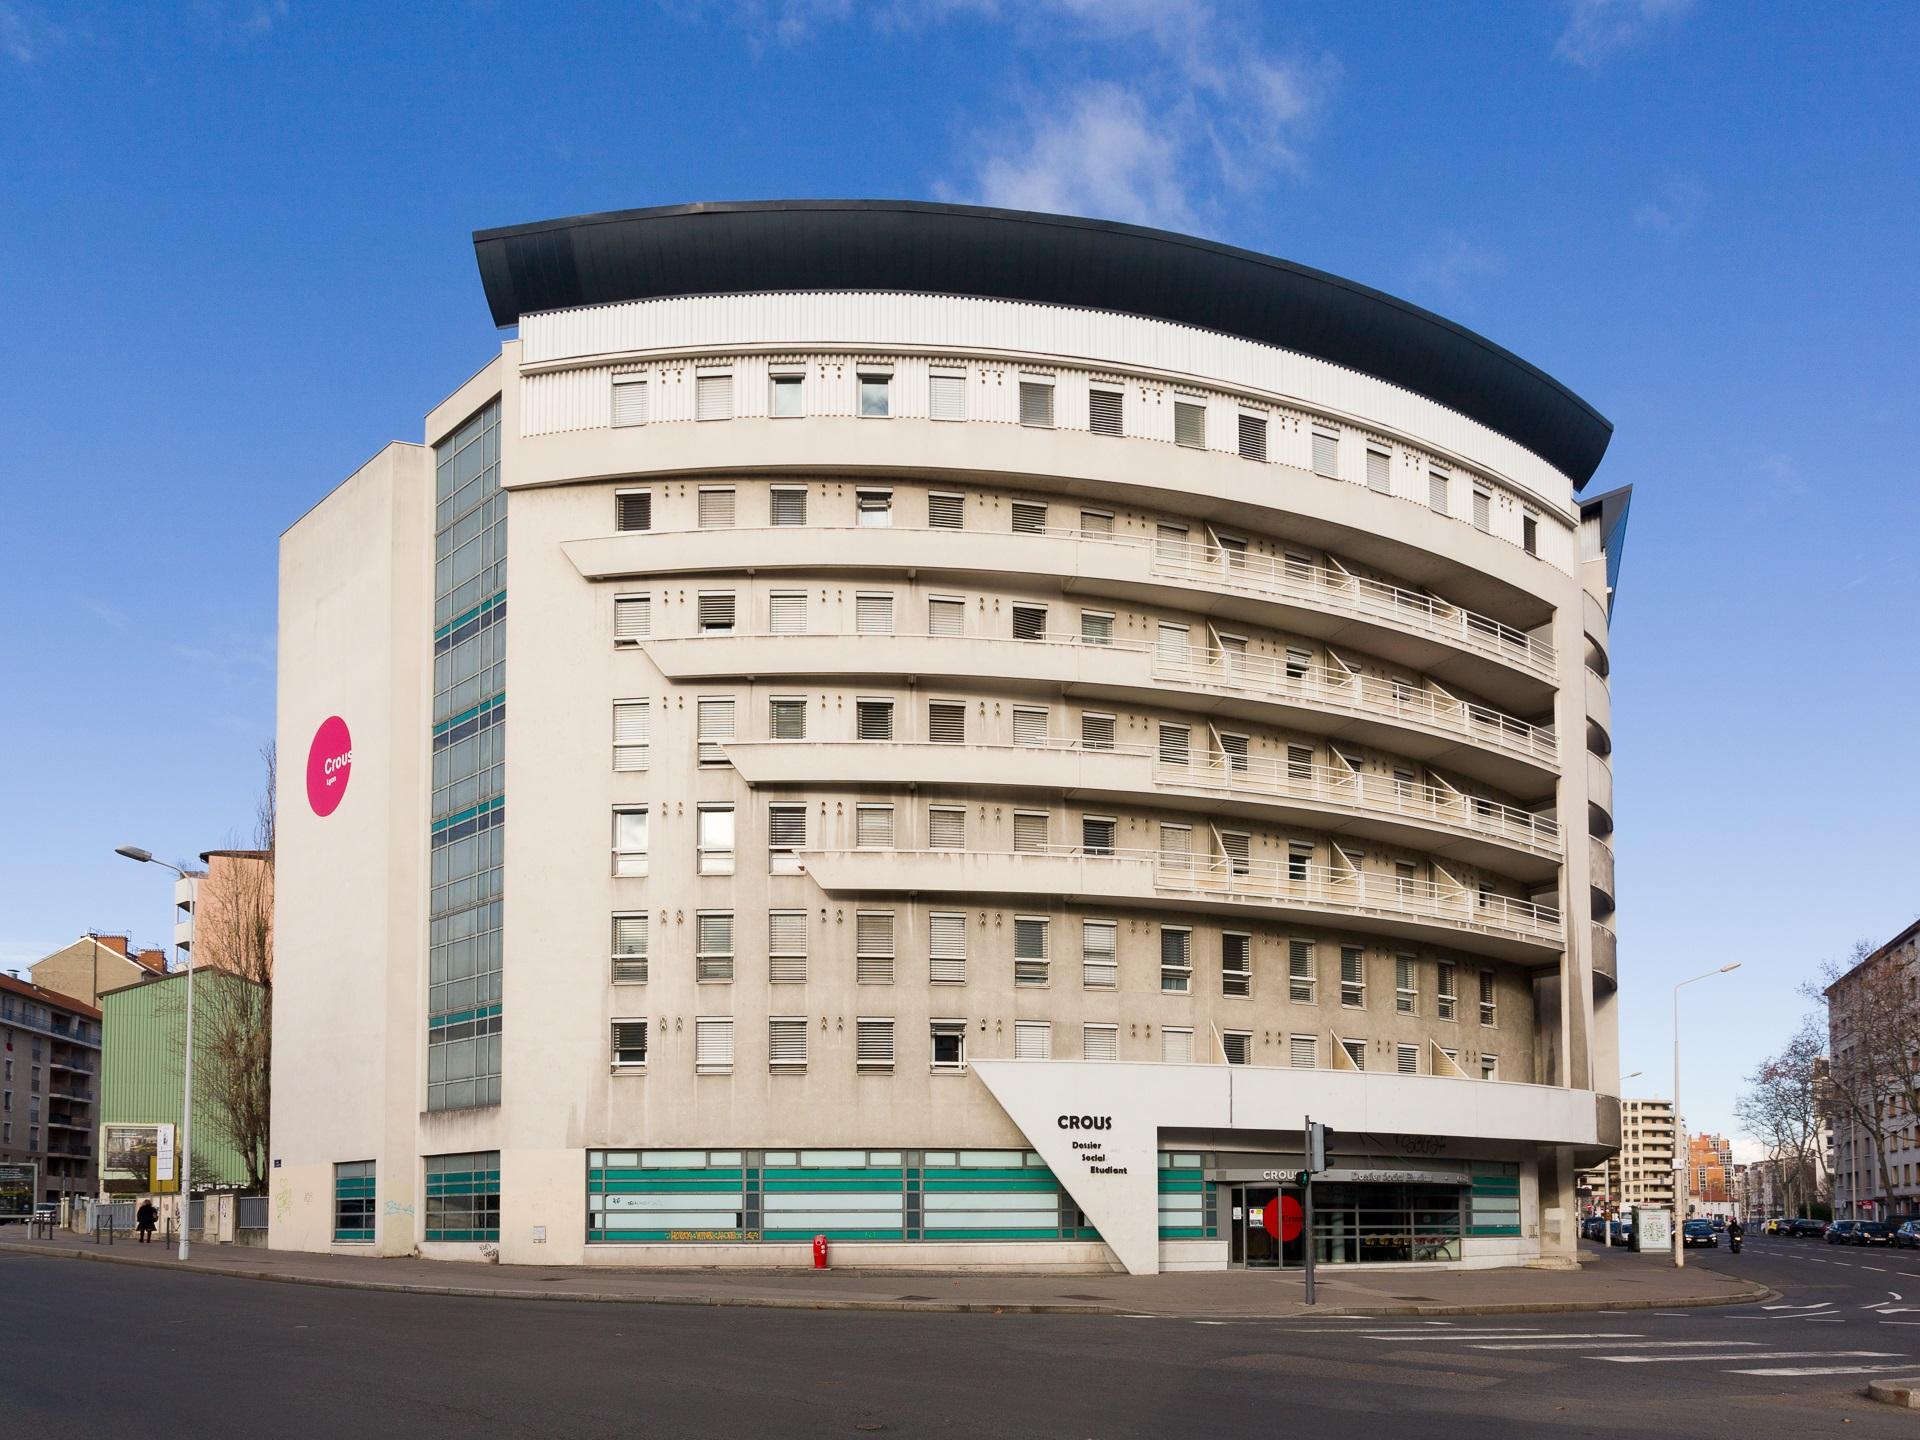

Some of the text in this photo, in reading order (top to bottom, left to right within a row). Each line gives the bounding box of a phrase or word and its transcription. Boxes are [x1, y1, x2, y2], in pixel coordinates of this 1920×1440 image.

[324, 750, 352, 774] Crous
[326, 776, 337, 786] Lyon
[1057, 1115, 1112, 1130] CROUS
[1072, 1141, 1101, 1150] Dossier
[1081, 1153, 1105, 1162] Social
[1090, 1166, 1128, 1175] Etudiant
[1263, 1170, 1297, 1180] CROU
